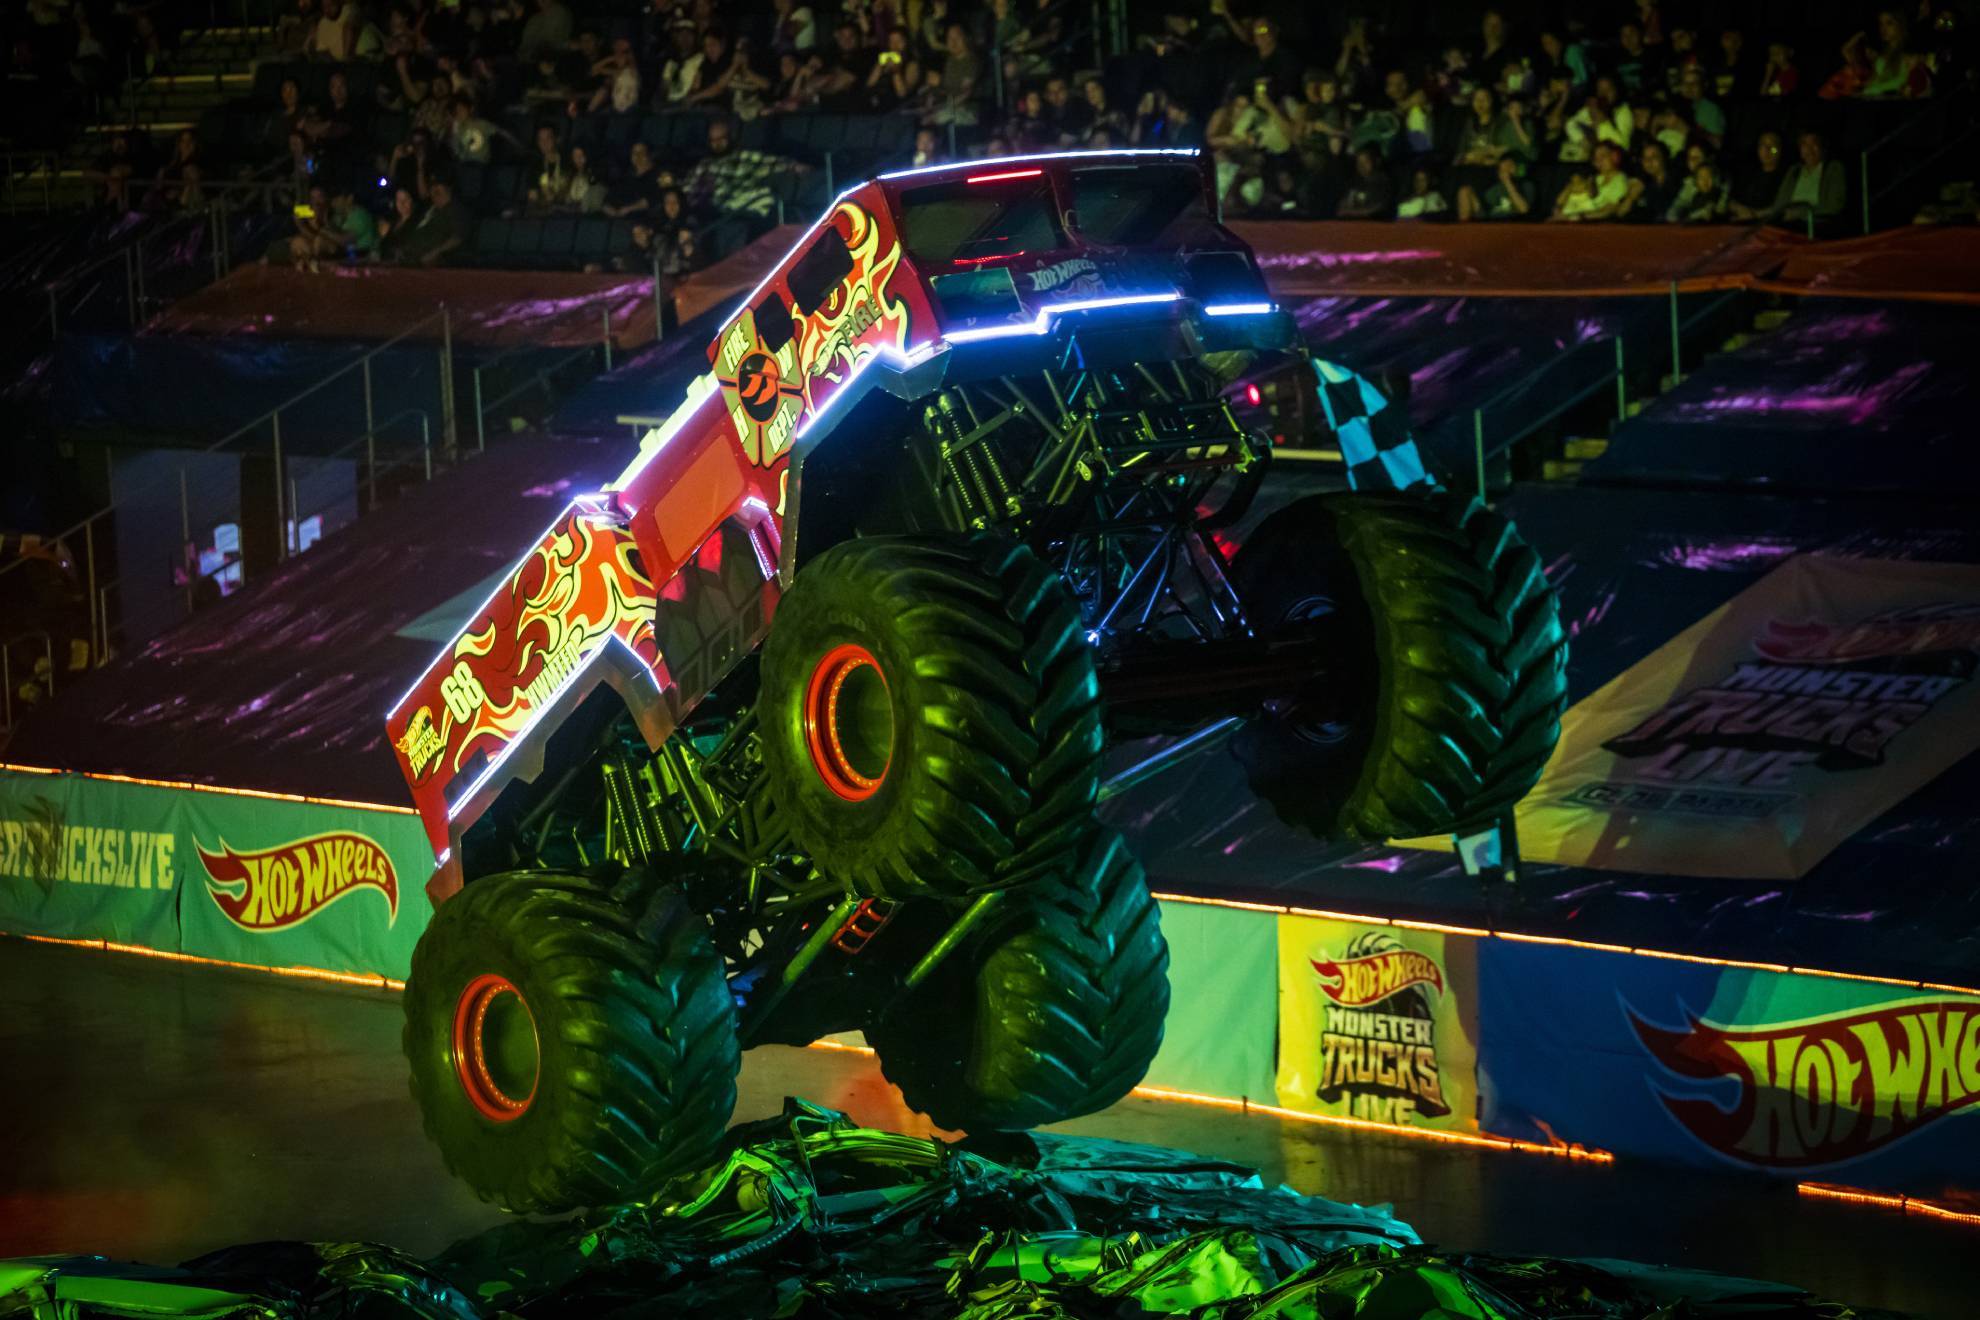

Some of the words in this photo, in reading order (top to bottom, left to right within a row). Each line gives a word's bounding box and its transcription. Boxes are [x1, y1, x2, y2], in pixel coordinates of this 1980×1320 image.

[839, 294, 884, 346] FIRE
[722, 322, 750, 374] FIRE
[775, 343, 794, 379] W
[732, 404, 750, 444] H
[767, 402, 797, 453] DEPT.
[441, 661, 485, 724] 68
[1721, 664, 1962, 702] MONSTER
[1627, 689, 1928, 760] TRUCKS
[409, 732, 443, 779] TRUCKS
[1638, 743, 1818, 786] LIVE
[1326, 1006, 1432, 1046] MONSTER
[1323, 1033, 1447, 1109] TRUCKS
[1341, 1090, 1416, 1126] LIVE
